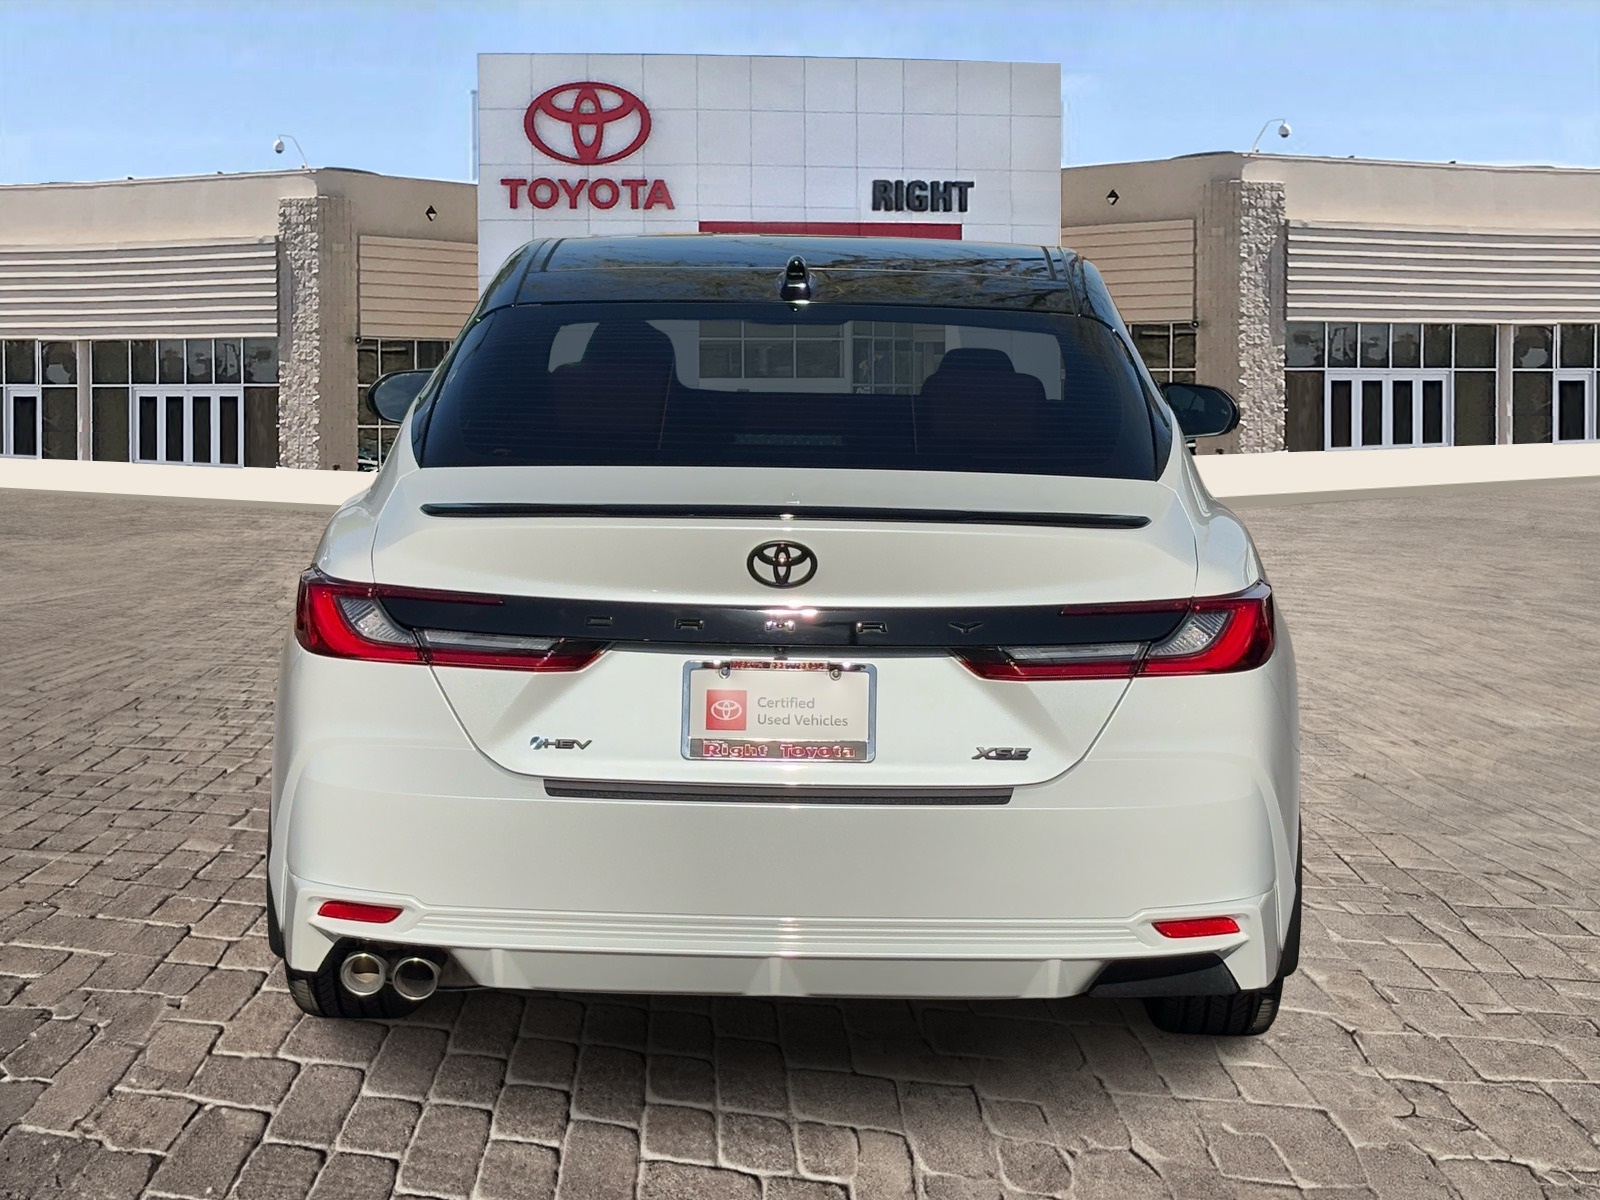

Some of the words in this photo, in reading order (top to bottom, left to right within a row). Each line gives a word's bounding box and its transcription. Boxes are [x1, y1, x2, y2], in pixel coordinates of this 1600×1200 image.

[500, 178, 675, 211] TOYOTA
[871, 179, 975, 213] RIGHT
[757, 697, 815, 709] Certified
[757, 714, 790, 726] Used
[794, 714, 848, 727] Vehicles
[543, 738, 592, 750] HEV
[702, 742, 769, 759] Right
[779, 744, 856, 760] Toyota
[971, 746, 1032, 761] XSE
